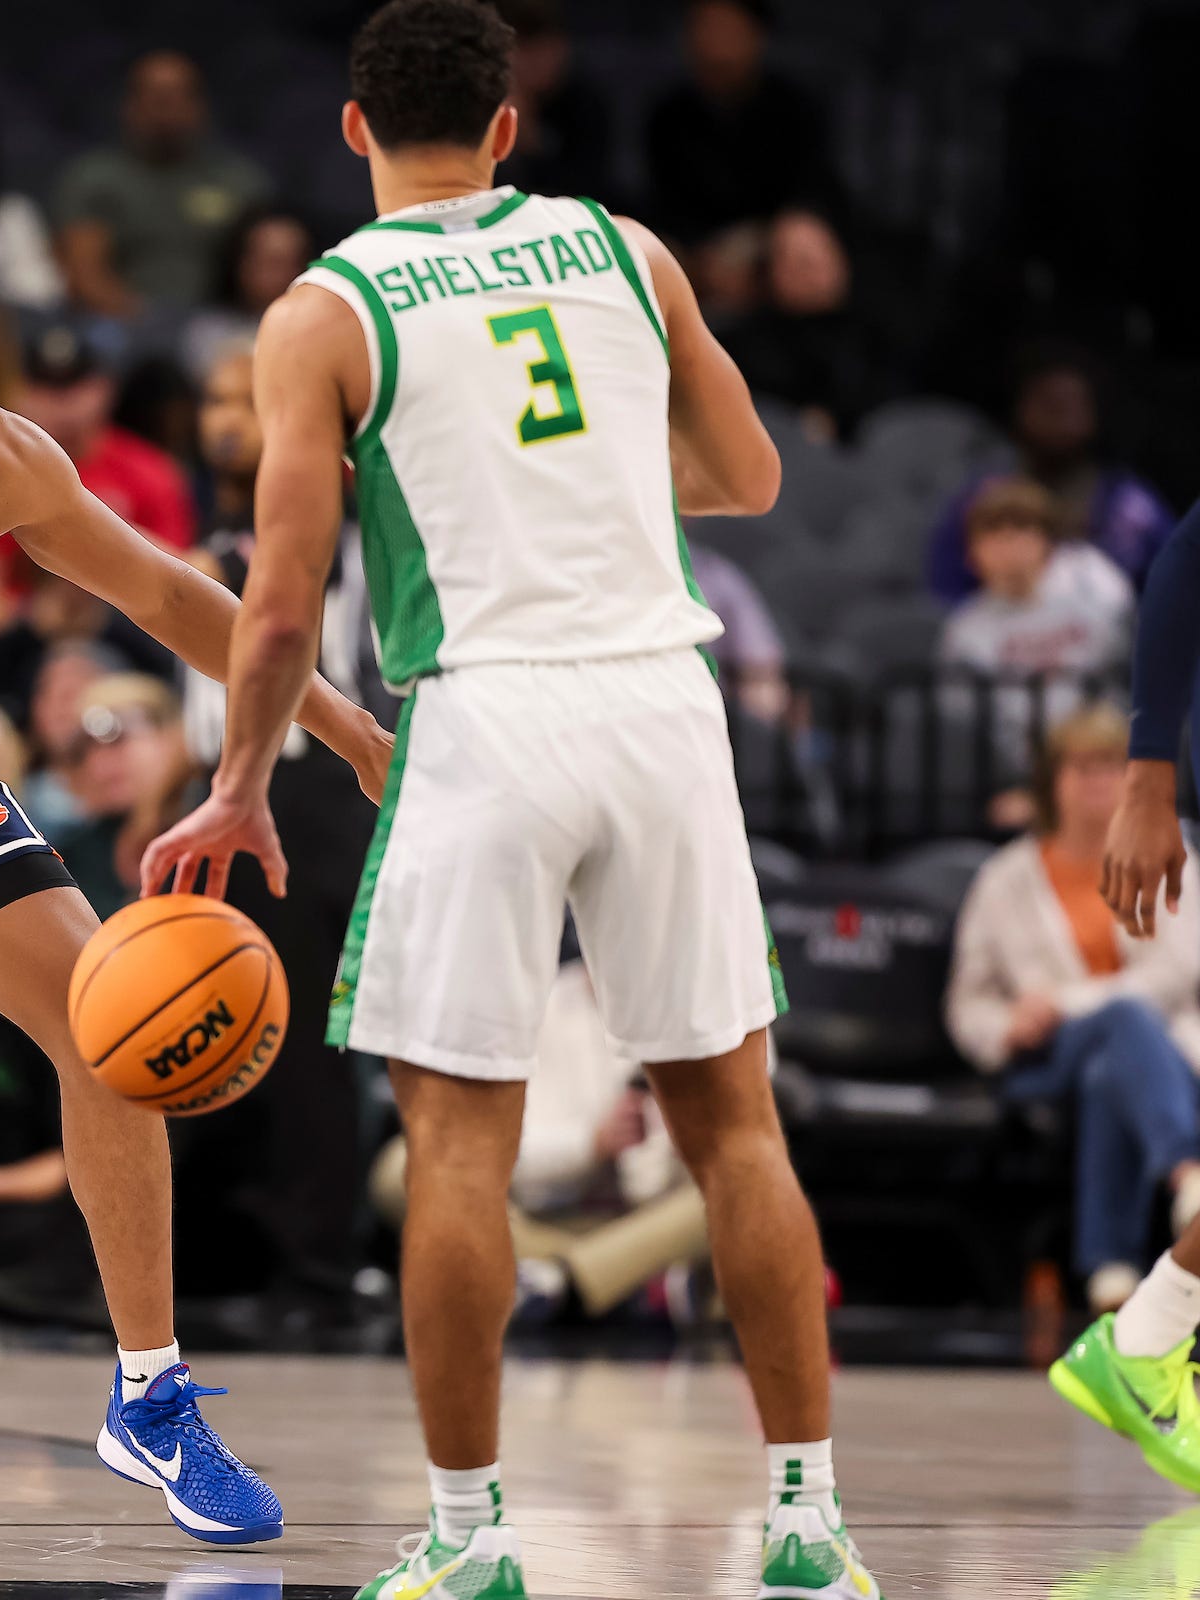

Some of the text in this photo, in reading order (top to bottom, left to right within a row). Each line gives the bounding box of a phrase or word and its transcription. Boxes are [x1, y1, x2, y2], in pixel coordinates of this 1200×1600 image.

[376, 230, 613, 312] SHELSTAD
[486, 304, 586, 446] 3
[144, 998, 236, 1080] NCAA
